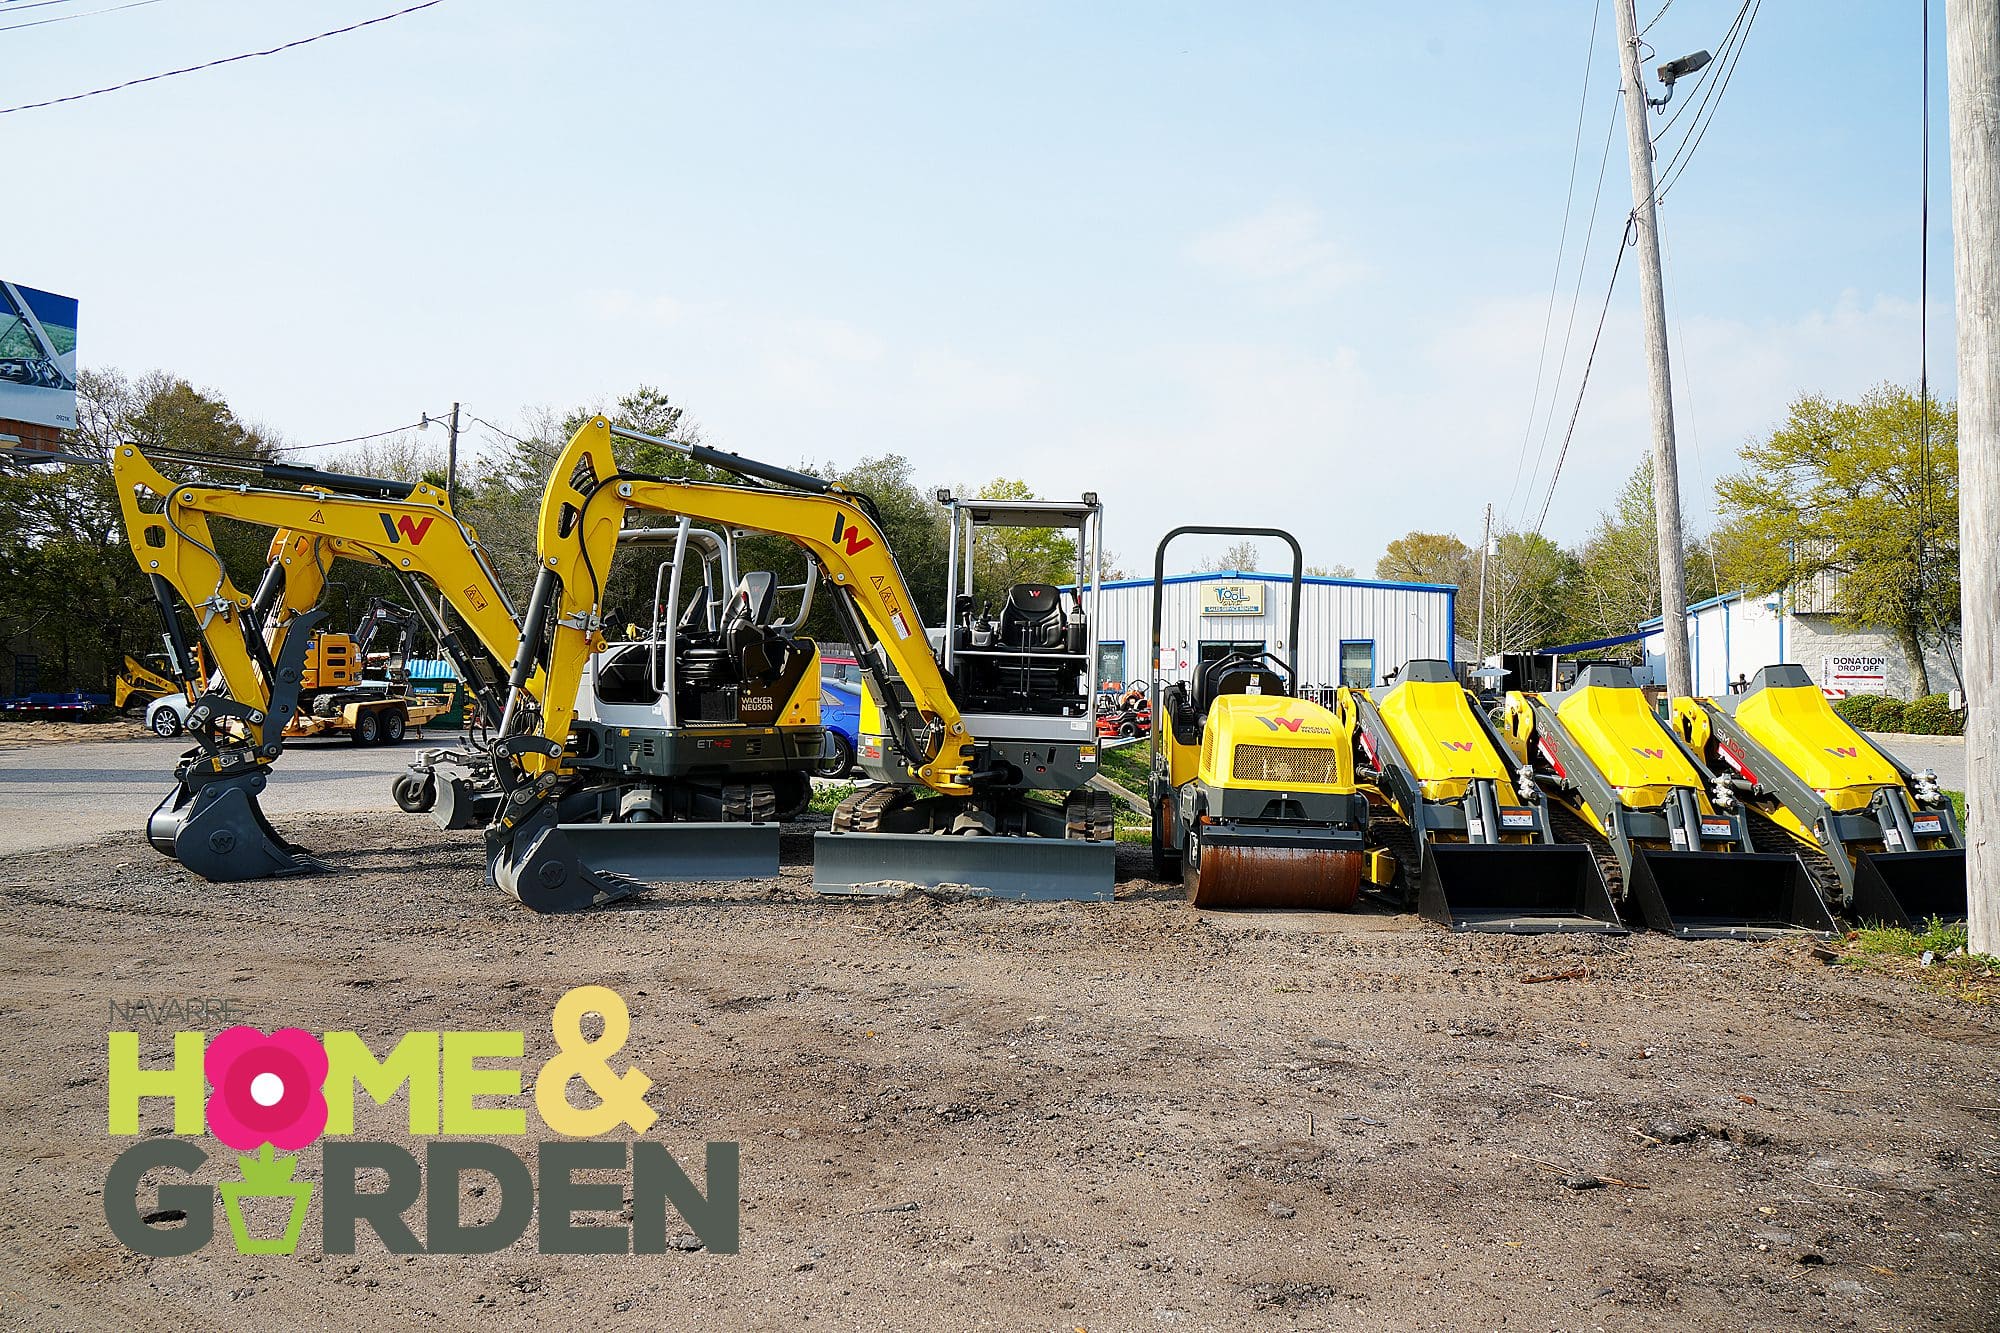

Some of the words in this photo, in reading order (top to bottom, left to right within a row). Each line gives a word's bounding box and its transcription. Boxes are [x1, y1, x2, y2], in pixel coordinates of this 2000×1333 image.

[1214, 587, 1250, 602] TOOL
[1833, 657, 1885, 665] DONATION
[697, 738, 732, 749] ET42
[1717, 728, 1745, 759] SM100
